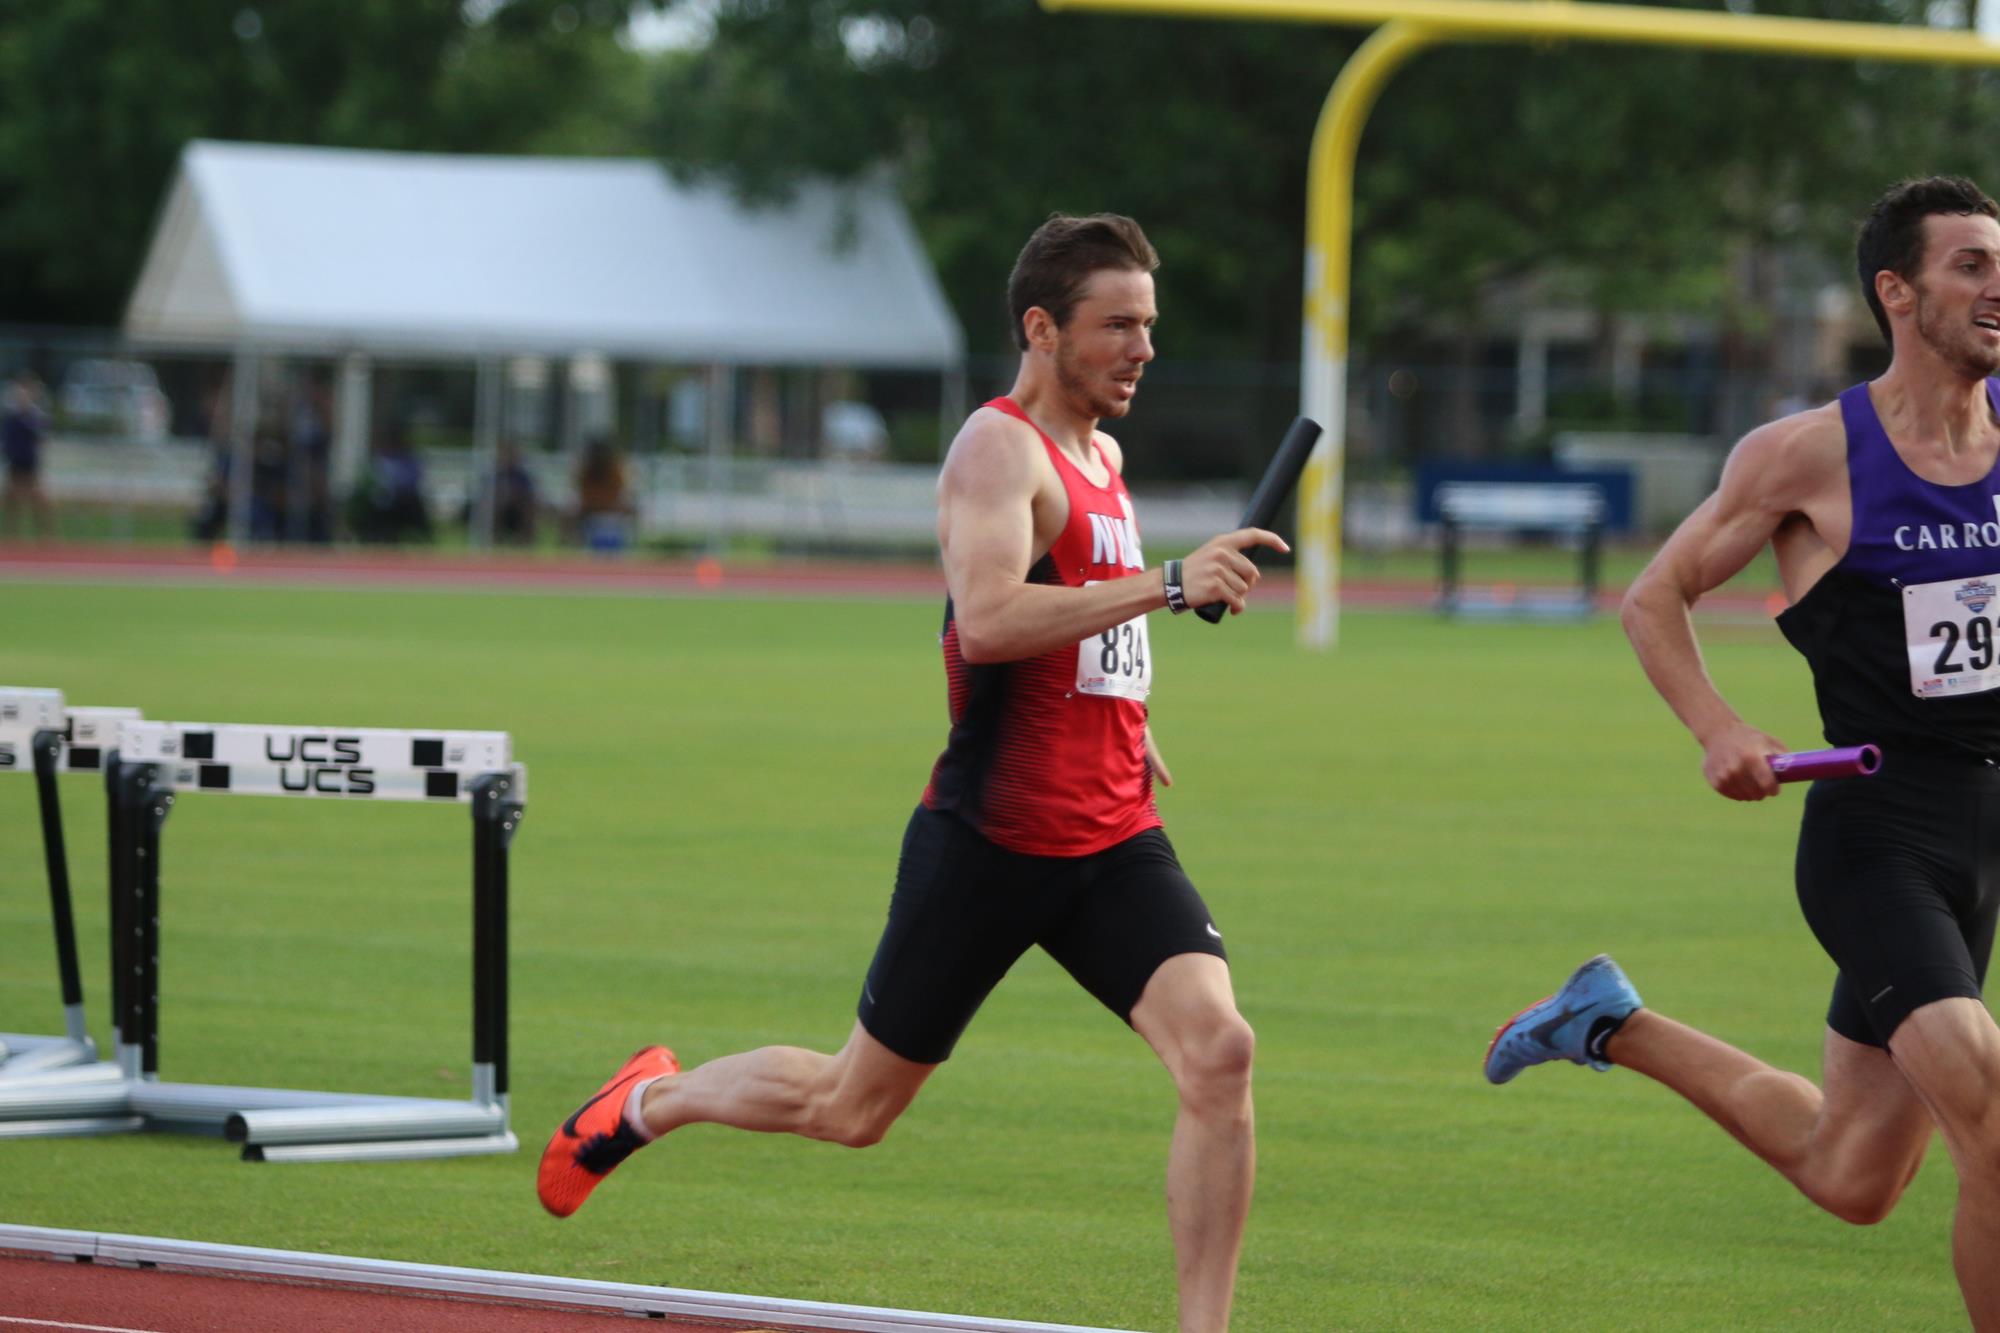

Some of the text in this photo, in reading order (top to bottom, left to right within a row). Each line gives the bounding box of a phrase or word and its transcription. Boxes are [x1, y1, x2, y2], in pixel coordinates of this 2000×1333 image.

[1893, 522, 2000, 551] CARRO
[1101, 623, 1144, 679] 834
[1929, 616, 2000, 675] 29
[265, 735, 360, 764] UCS
[280, 766, 375, 794] UCS
